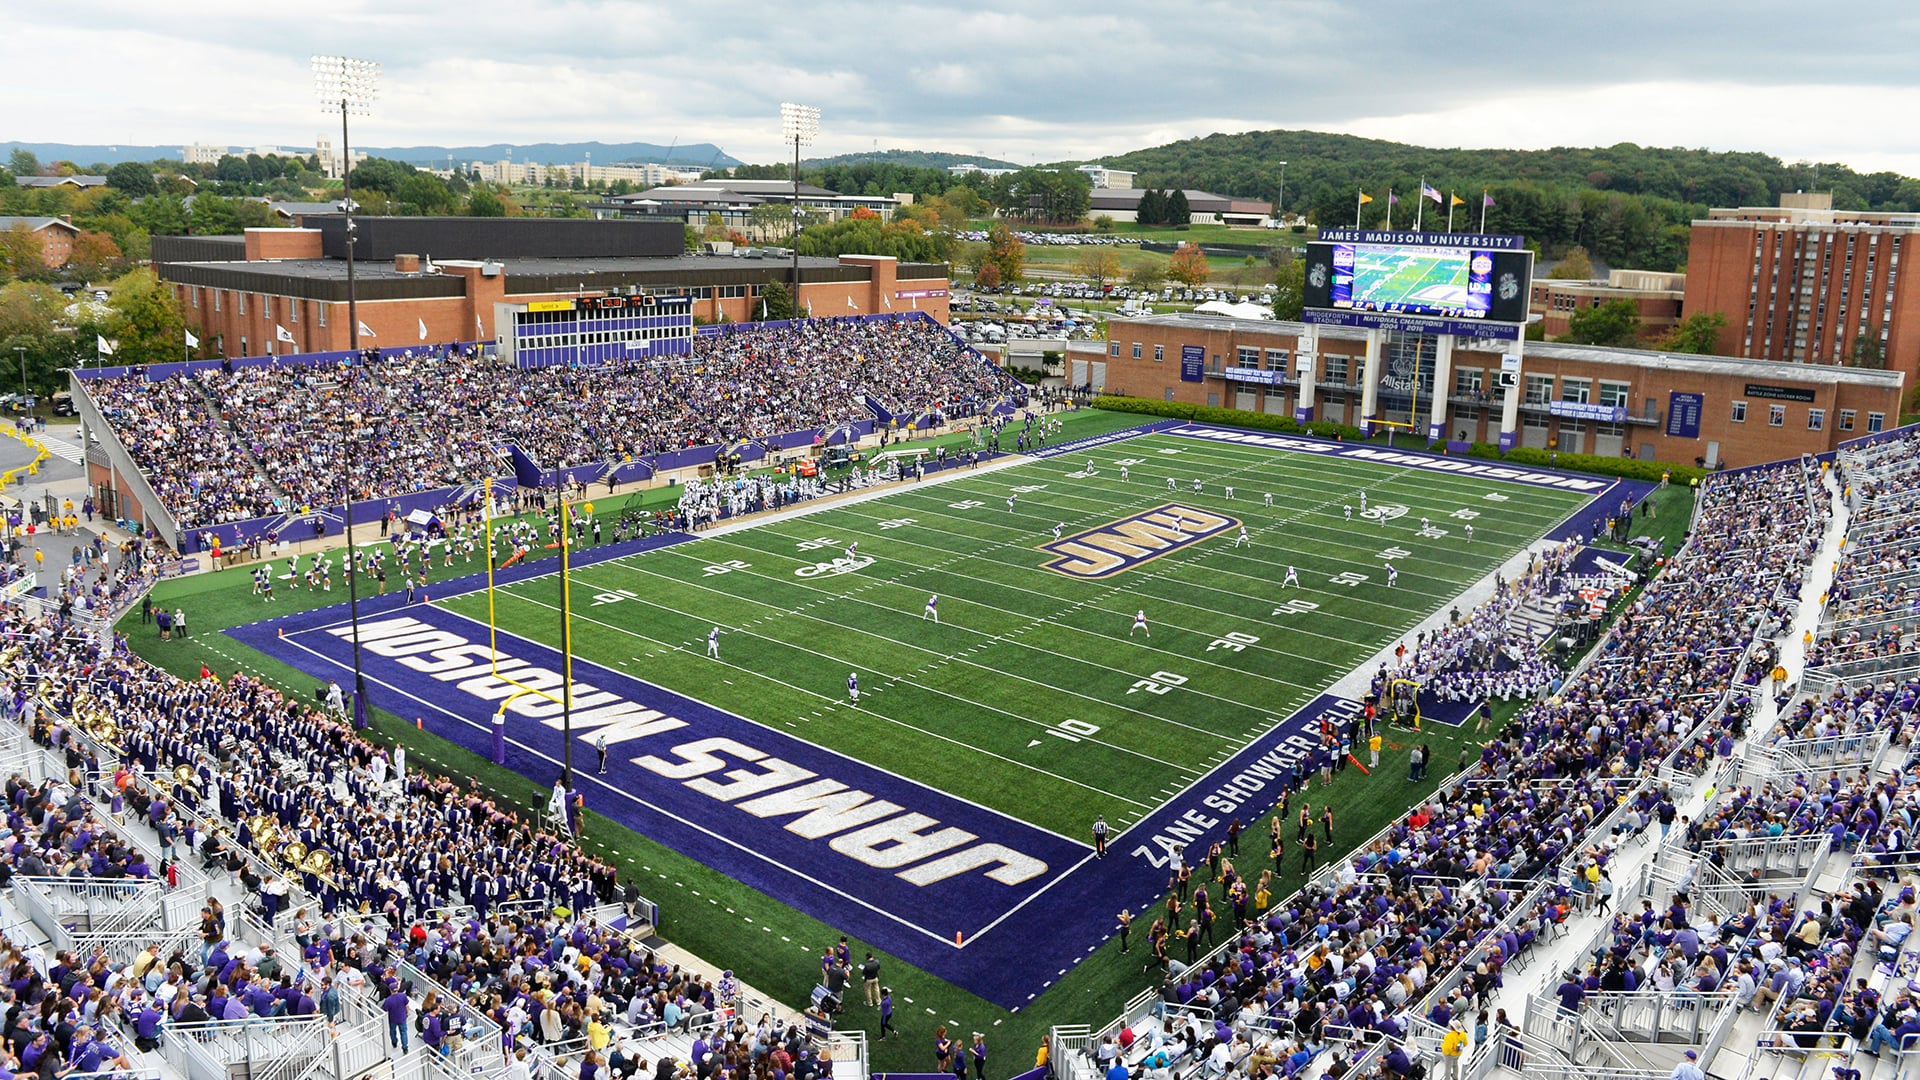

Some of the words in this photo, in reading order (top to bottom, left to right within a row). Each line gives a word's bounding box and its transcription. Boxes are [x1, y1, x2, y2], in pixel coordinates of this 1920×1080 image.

[1321, 231, 1360, 241] JAMES
[1365, 232, 1424, 244] MADISON
[1430, 234, 1513, 247] UNIVERSITY
[1306, 311, 1350, 319] BRIDGEFORTH
[1312, 317, 1342, 325] STADIUM
[1363, 315, 1399, 324] NATIONAL
[1400, 318, 1444, 328] CHAMPIONS
[1457, 323, 1476, 331] ZANE
[1478, 324, 1514, 333] SHOWKER
[1474, 330, 1495, 338] FIELD
[1380, 374, 1421, 391] Allstate
[1510, 374, 1518, 385] 9
[1169, 427, 1344, 453] JAMES
[1340, 447, 1606, 491] MADISON
[947, 499, 985, 509] 50
[796, 536, 842, 551] 30
[1046, 505, 1235, 577] JMU
[702, 559, 752, 575] 20
[1329, 571, 1370, 587] 50
[592, 588, 639, 604] 10
[1278, 599, 1320, 615] 40
[1209, 631, 1261, 652] 30
[325, 616, 691, 746] MADISON
[1132, 671, 1189, 695] 20
[1045, 718, 1101, 743] 10
[1131, 808, 1219, 869] ZANE
[1203, 734, 1318, 814] SHOWKER
[629, 736, 1049, 887] JAMES
